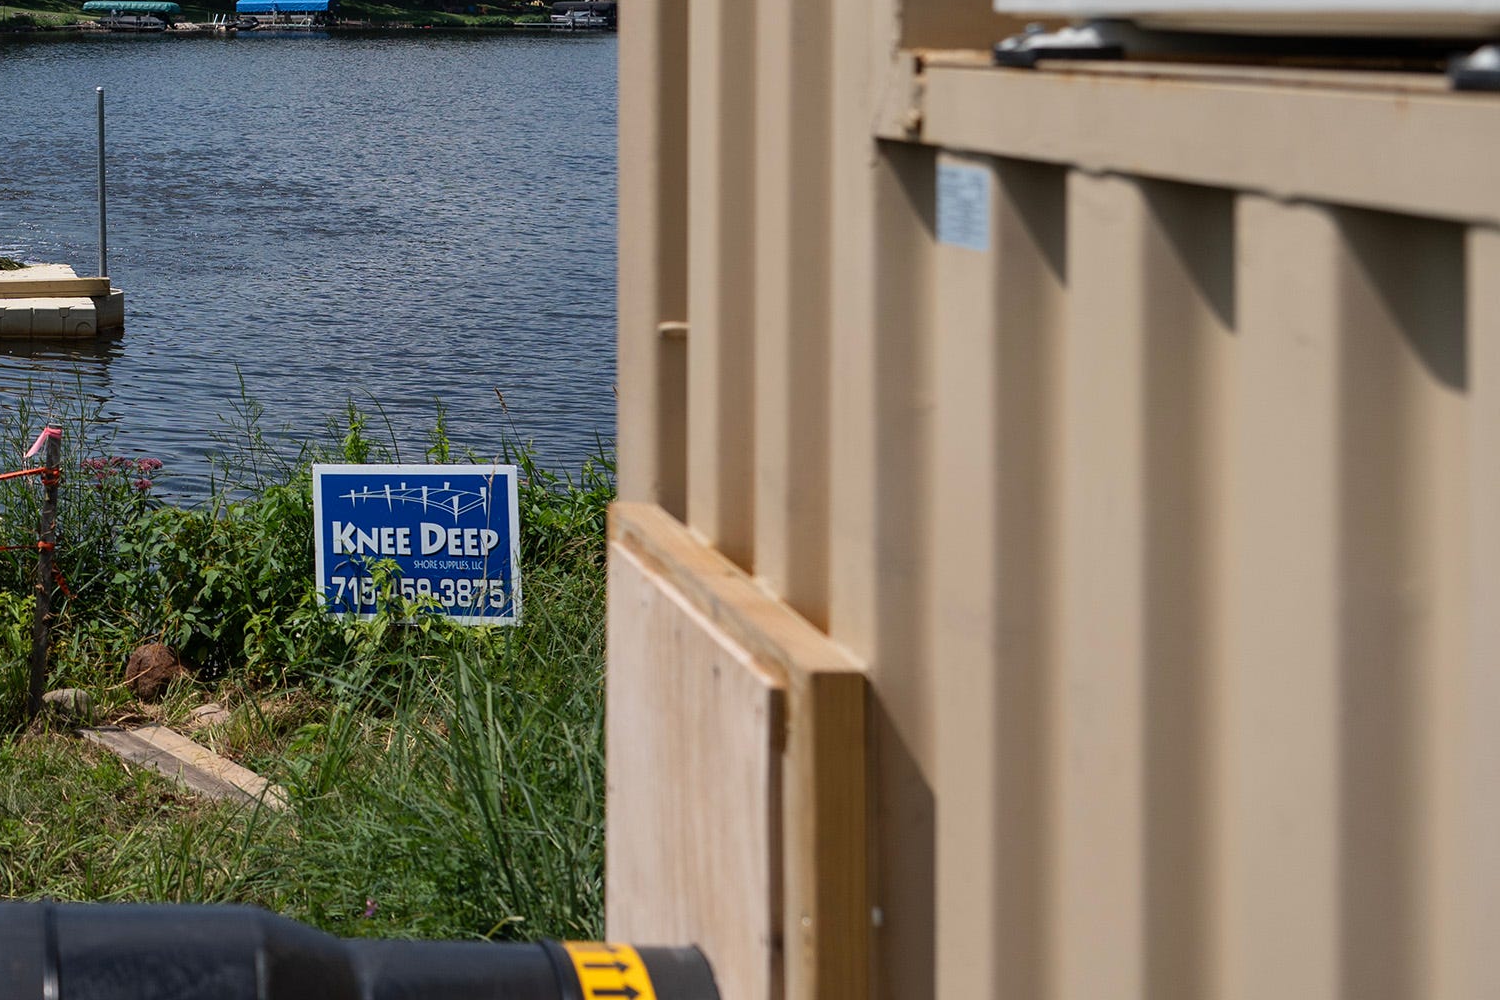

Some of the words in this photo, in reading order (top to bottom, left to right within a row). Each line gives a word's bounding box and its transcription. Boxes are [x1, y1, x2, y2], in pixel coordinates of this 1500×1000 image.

[332, 521, 411, 555] KNEE
[420, 522, 499, 556] DEEP
[413, 559, 438, 570] SHORE
[438, 560, 471, 571] SUPPLIES,
[471, 560, 484, 570] LLC
